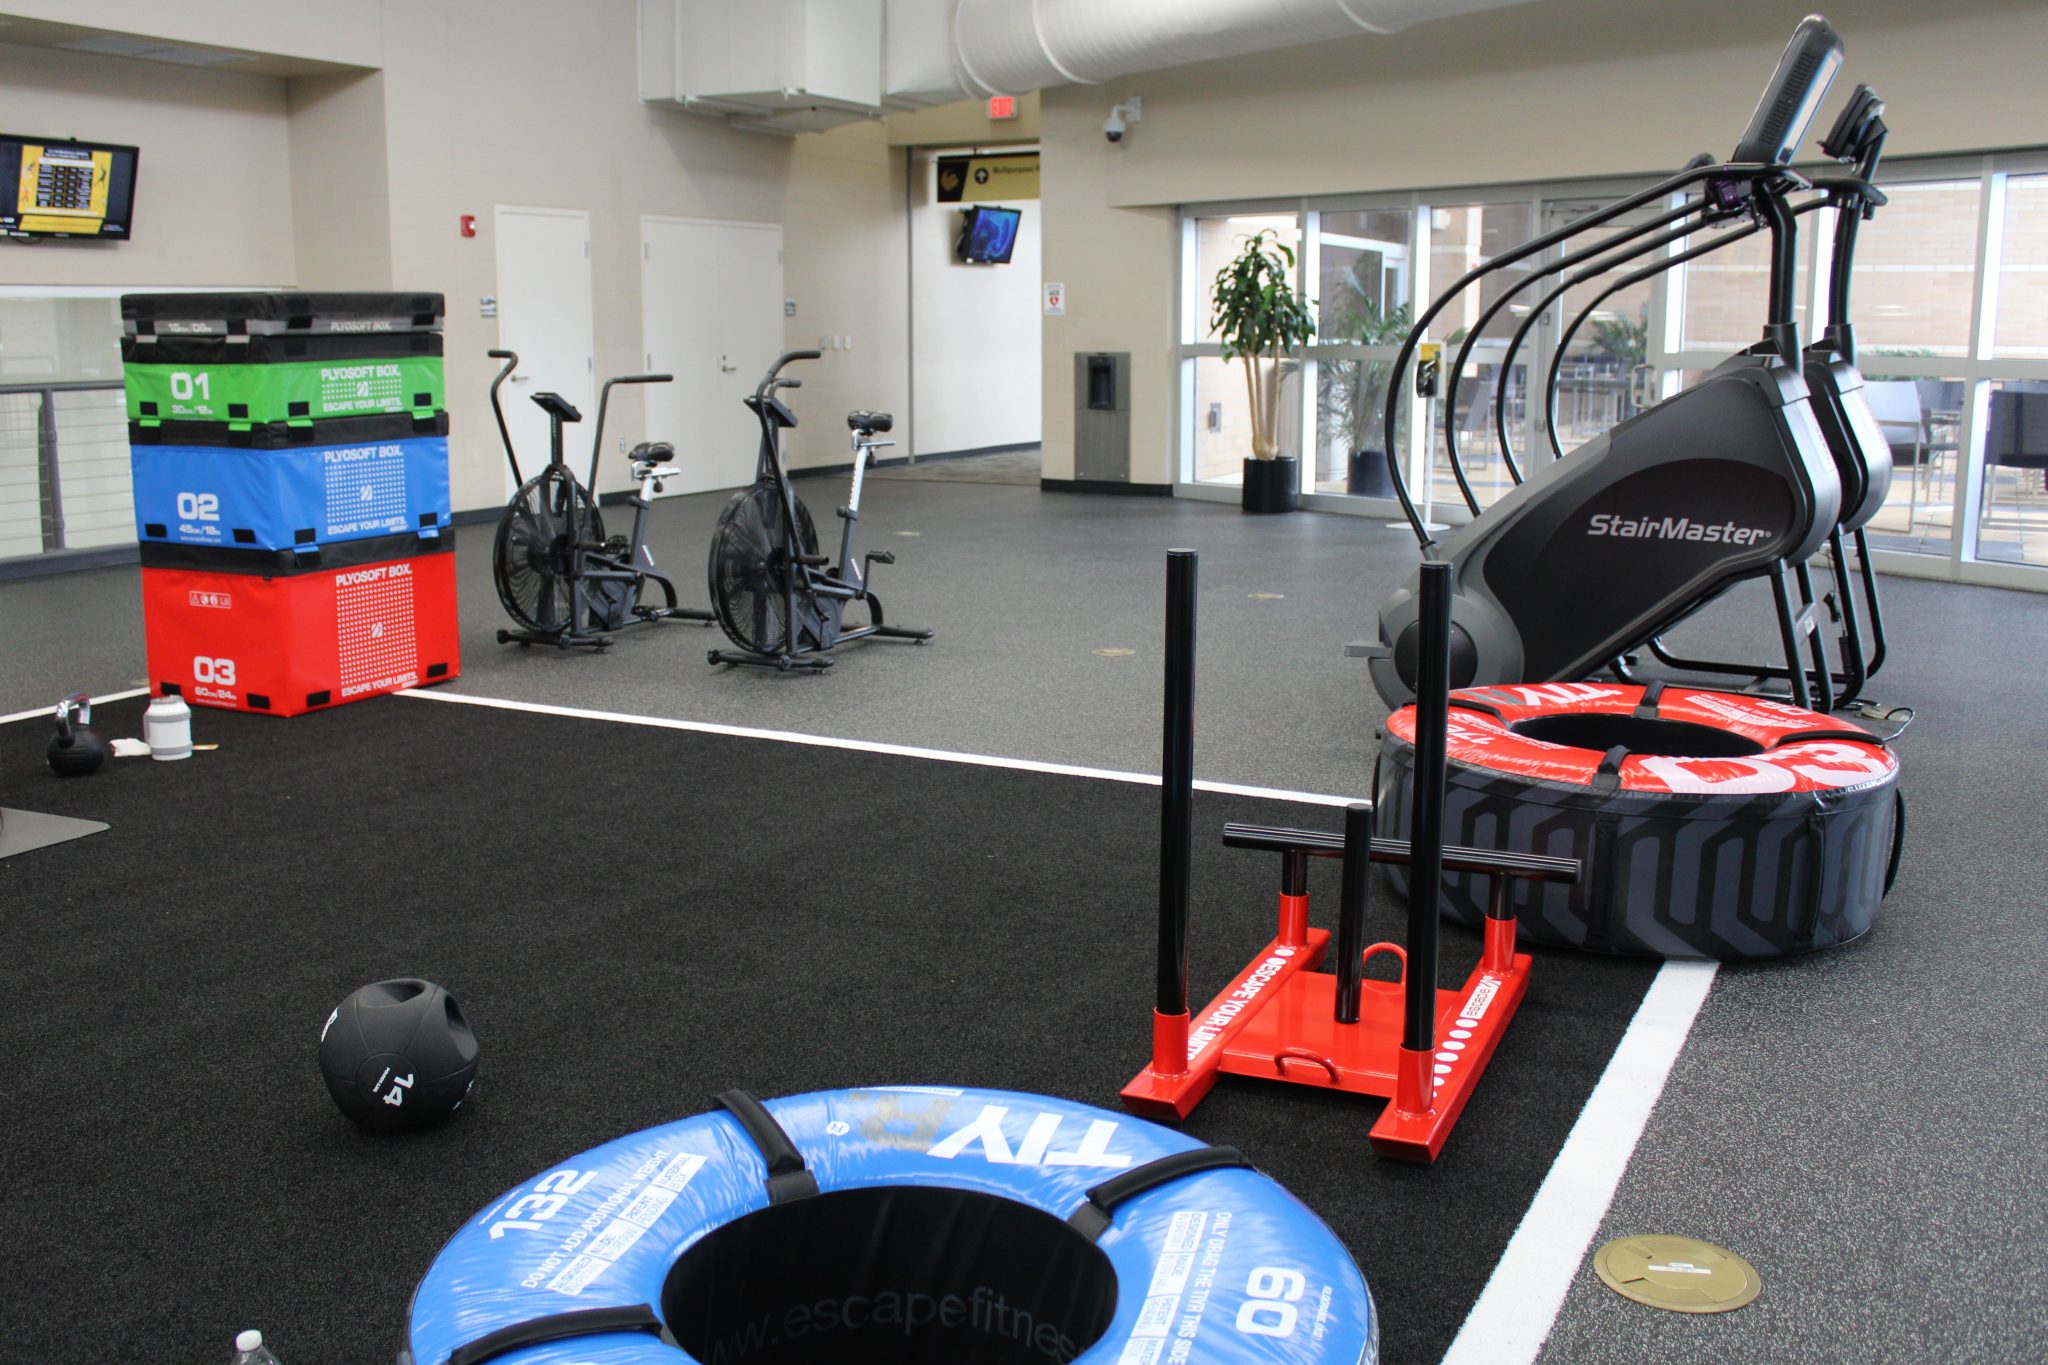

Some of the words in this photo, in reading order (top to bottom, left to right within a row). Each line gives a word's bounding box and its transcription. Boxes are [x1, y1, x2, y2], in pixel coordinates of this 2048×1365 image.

[321, 365, 375, 381] PLYOSOFT
[376, 363, 401, 378] BOX.
[170, 372, 210, 400] 01
[323, 401, 354, 412] ESCAPE
[354, 399, 376, 409] YOUR
[324, 446, 377, 463] PLYOSOFT
[378, 444, 404, 458] BOX.
[177, 492, 220, 521] 02
[328, 523, 358, 535] ESCAPE
[359, 519, 380, 531] YOUR
[1588, 514, 1765, 545] StairMaster
[336, 567, 387, 587] PLYOSOFT
[388, 563, 413, 578] BOX.
[193, 655, 236, 686] 03
[341, 682, 371, 697] ESCAPE
[372, 677, 393, 690] YOUR
[1232, 963, 1282, 999] ESCAPE
[1205, 999, 1249, 1027] YOUR
[383, 1073, 414, 1107] 14
[488, 1169, 599, 1240] 132
[623, 1194, 654, 1219] PATENT
[520, 1272, 545, 1288] DO
[538, 1250, 567, 1272] NOT
[560, 1231, 588, 1252] ADD
[581, 1182, 640, 1232] ADDITIONAL
[1179, 1213, 1202, 1249] DESIGNED
[1211, 1212, 1232, 1237] ONLY
[1171, 1255, 1188, 1276] MADE
[1202, 1238, 1225, 1266] DRAG
[1195, 1266, 1216, 1288] THE
[1154, 1298, 1173, 1324] PATENT
[1186, 1289, 1210, 1316] TIYR
[1236, 1266, 1306, 1338] 60
[1178, 1313, 1202, 1339] THIS
[1168, 1338, 1193, 1365] SIDE
